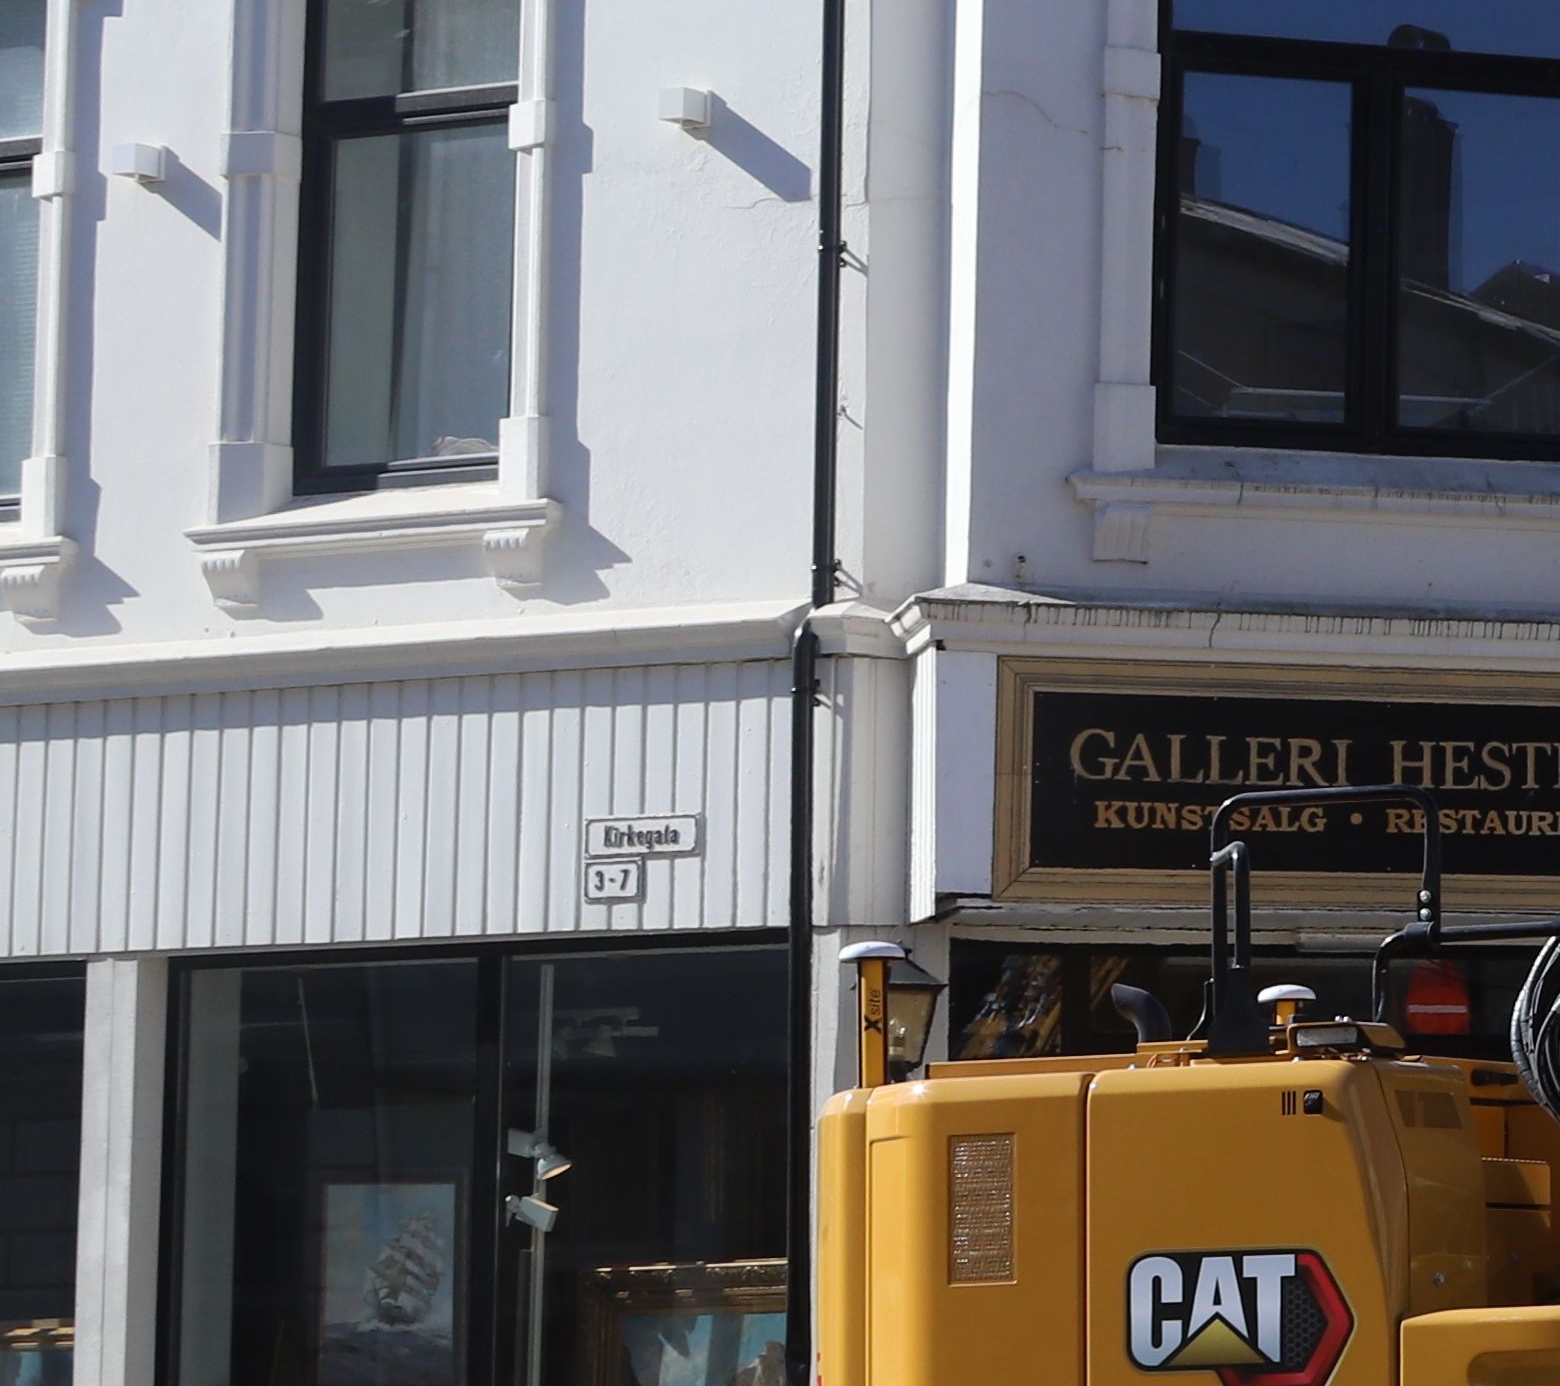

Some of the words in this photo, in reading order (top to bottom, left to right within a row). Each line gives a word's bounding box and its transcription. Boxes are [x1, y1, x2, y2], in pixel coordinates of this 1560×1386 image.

[1069, 728, 1353, 787] GALLERI
[1094, 800, 1327, 833] KUNSTSALG
[1130, 1254, 1295, 1366] CAT
